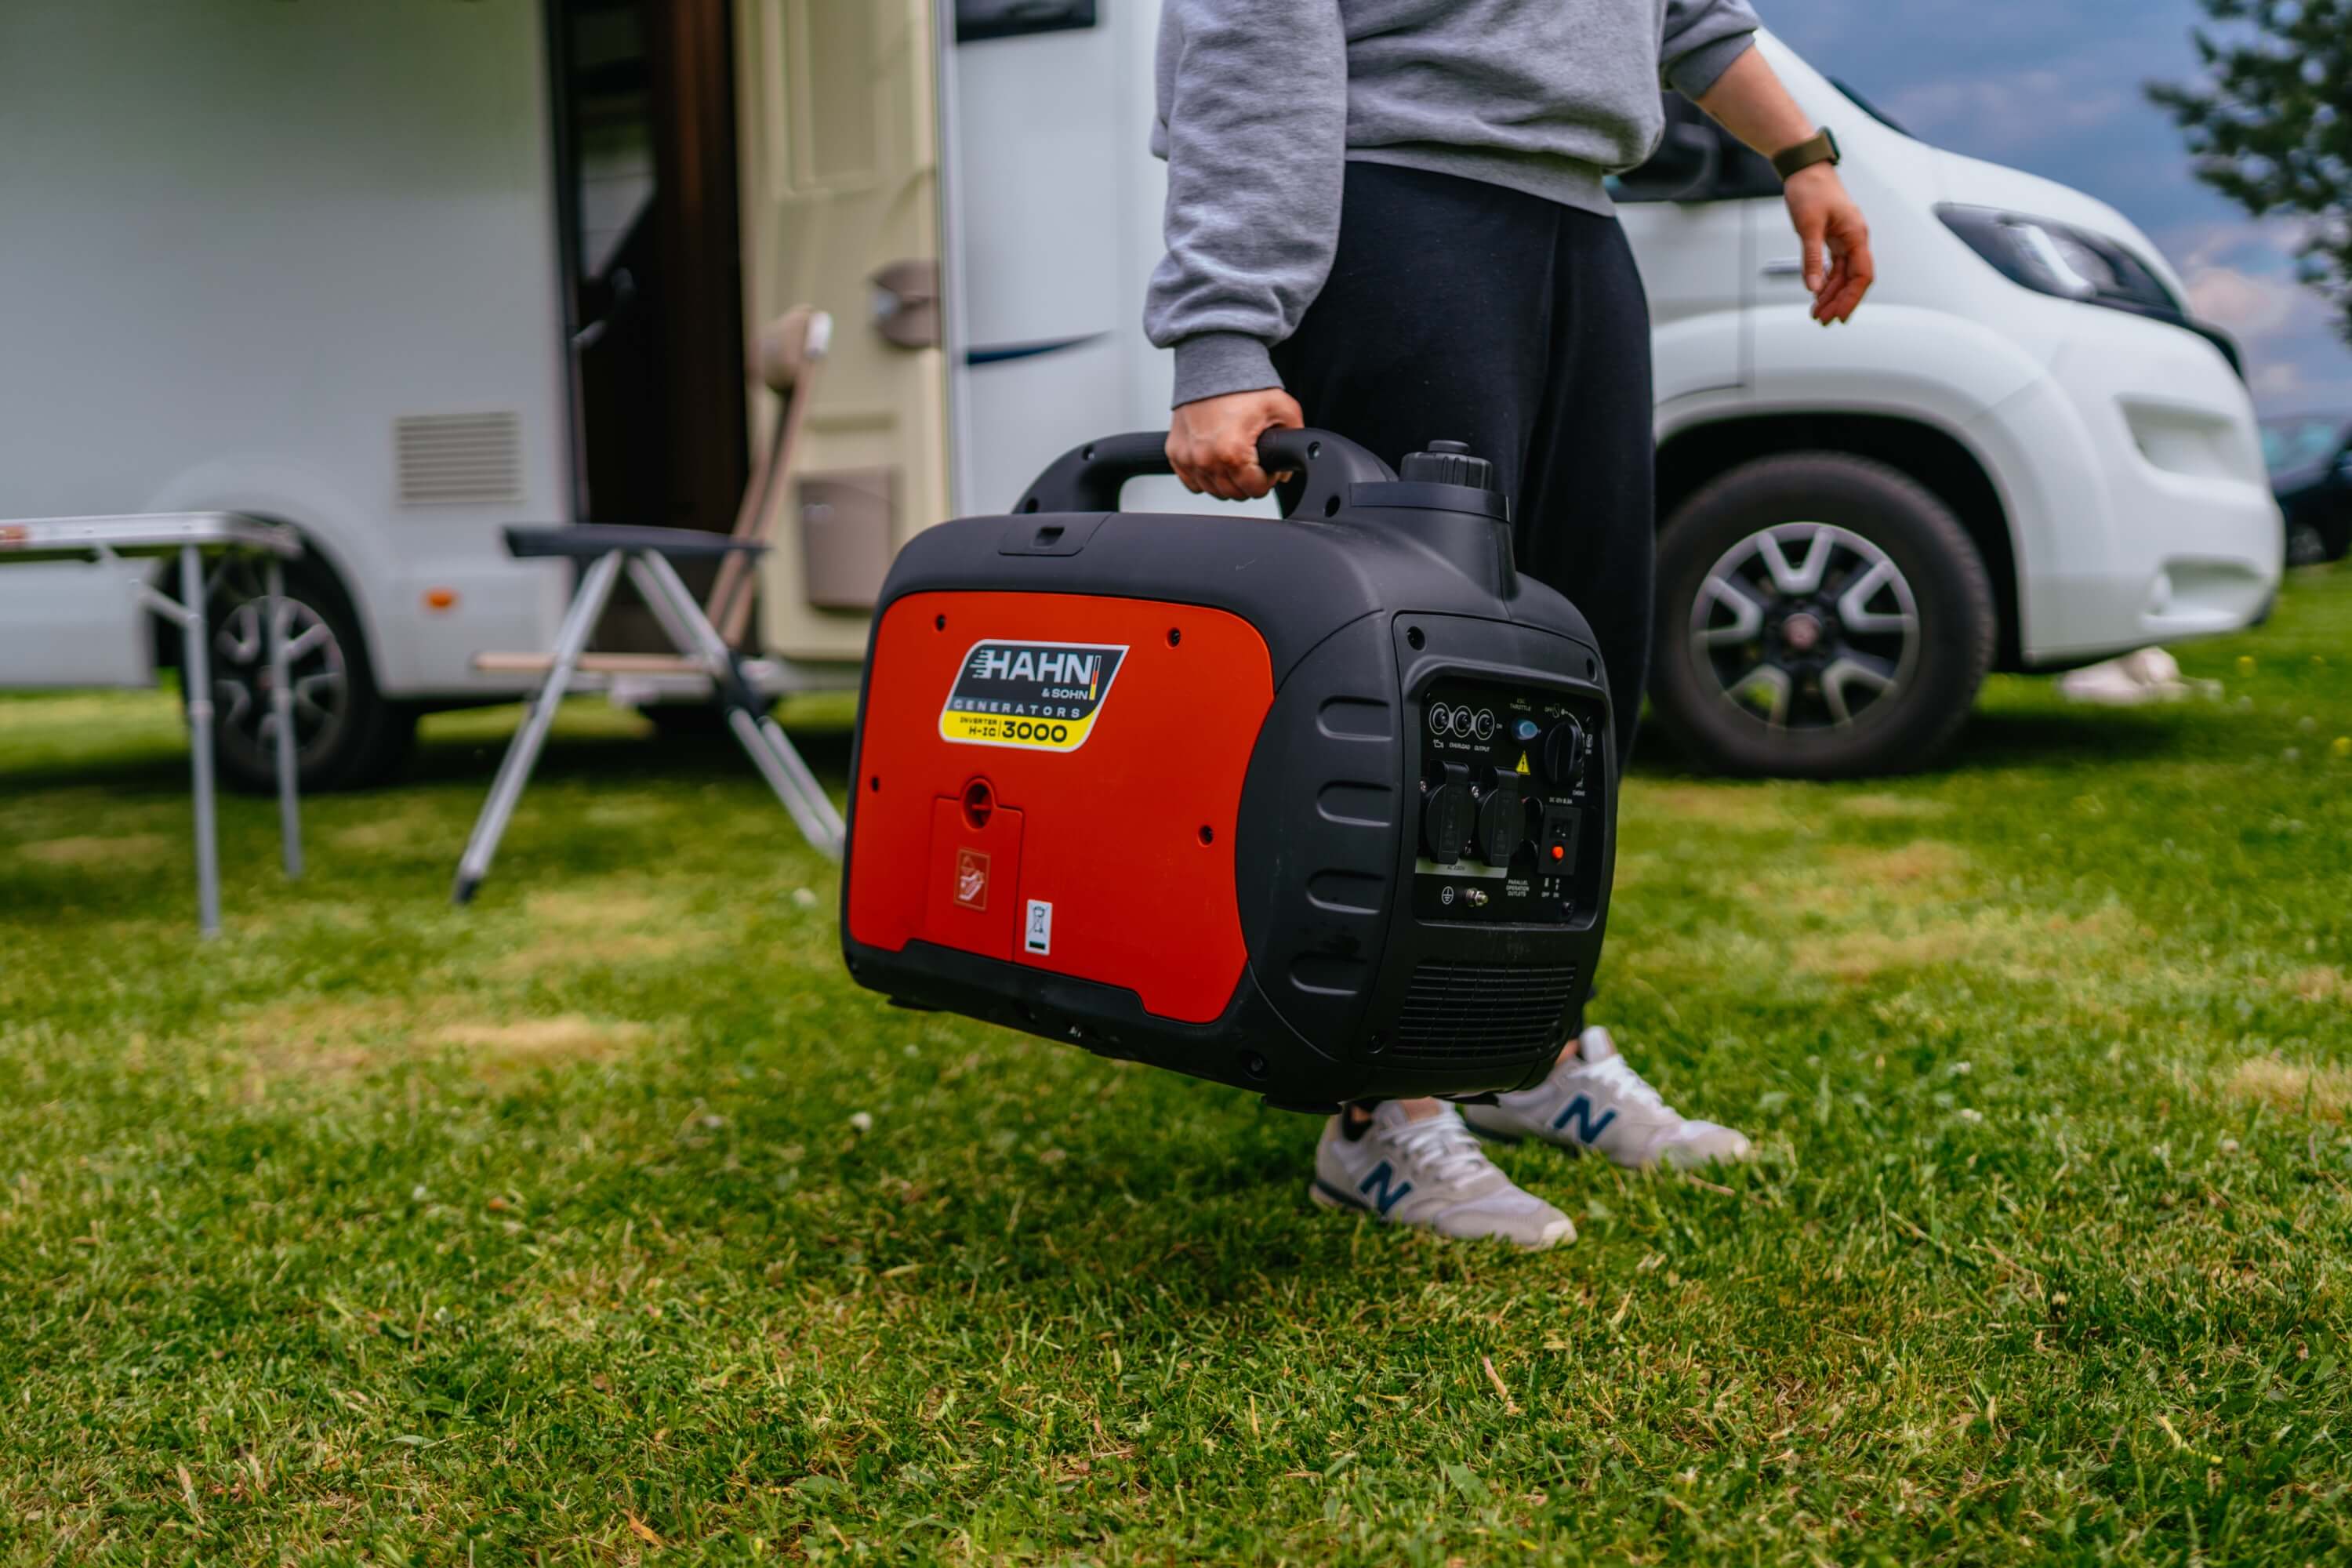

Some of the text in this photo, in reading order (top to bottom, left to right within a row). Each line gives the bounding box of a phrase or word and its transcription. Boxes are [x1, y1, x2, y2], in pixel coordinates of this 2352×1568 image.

[971, 649, 1094, 685] HAHN
[1041, 688, 1088, 700] & SOHN
[953, 699, 1081, 719] GENERATORS
[960, 716, 998, 726] INVERTER
[968, 726, 996, 738] H-IC
[1001, 720, 1068, 743] 3000
[1450, 742, 1490, 753] OVERLOAD OUTPUT
[1554, 1094, 1616, 1145] N
[1359, 1160, 1412, 1214] N
